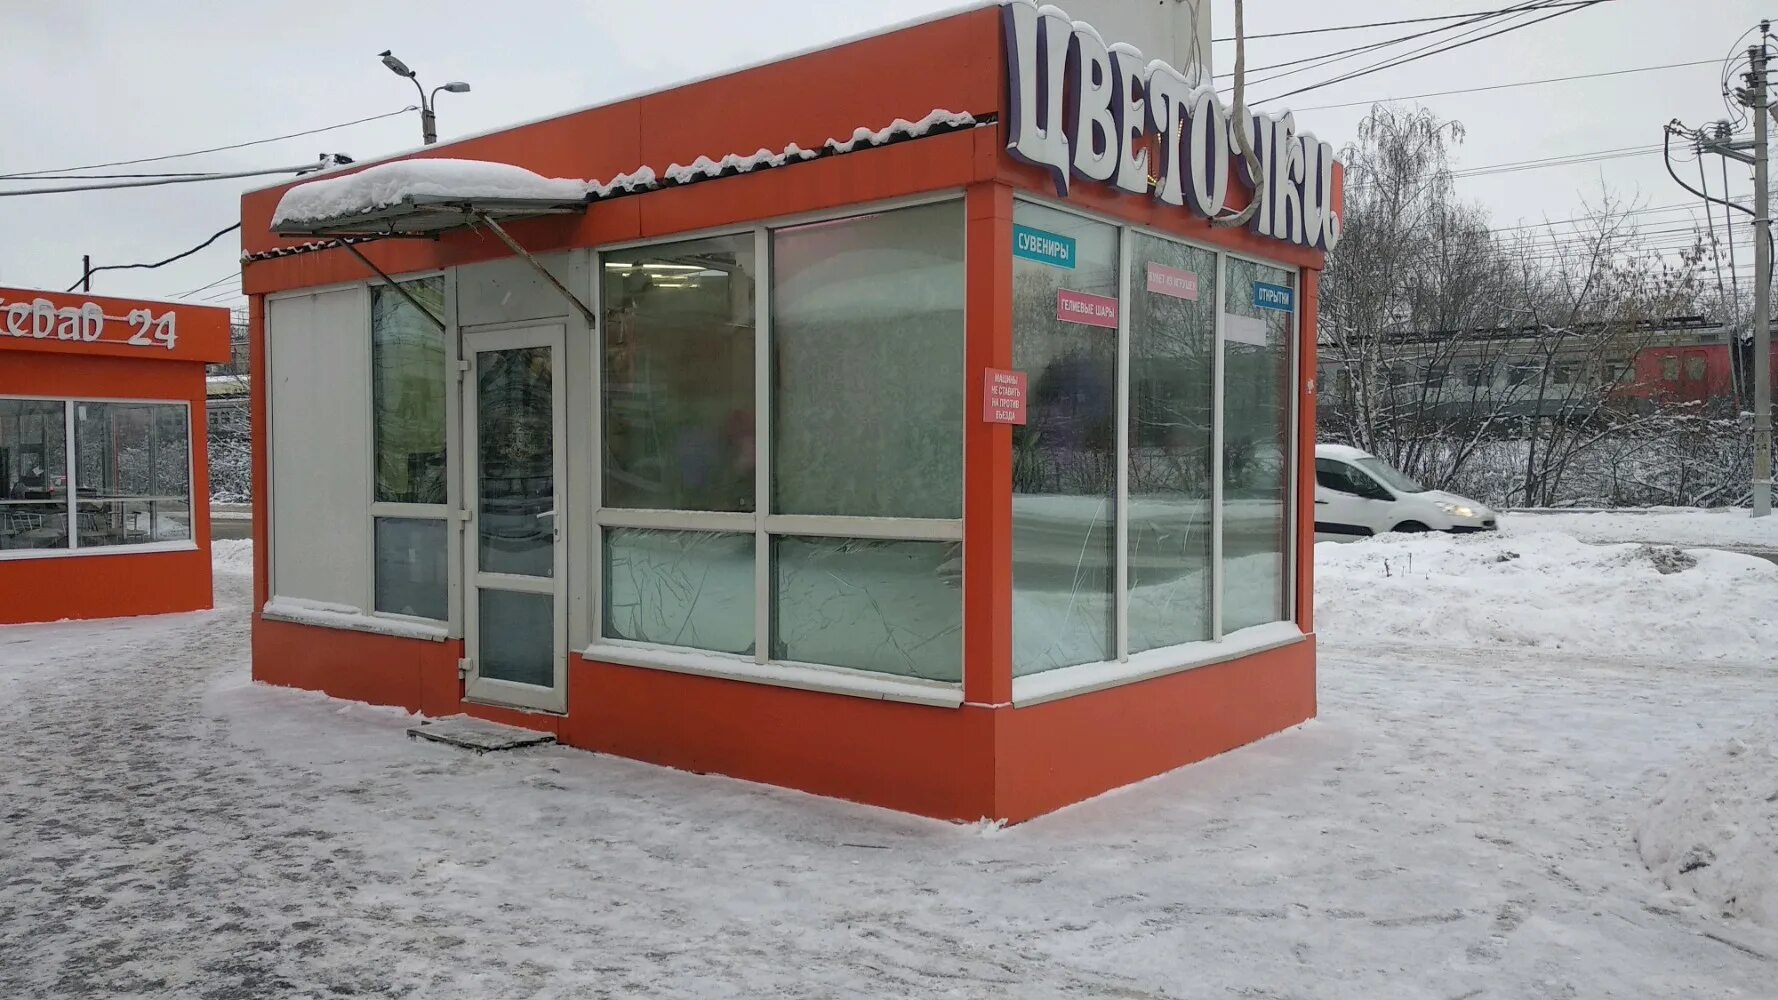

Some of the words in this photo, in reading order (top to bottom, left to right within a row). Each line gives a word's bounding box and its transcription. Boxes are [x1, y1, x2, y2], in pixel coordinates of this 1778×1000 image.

[1018, 232, 1069, 260] СУВЕНИРЫ
[1258, 287, 1290, 305] ОТКРЫТКИ
[1060, 298, 1094, 315] ГЕЛИЕВЫЕ
[1095, 305, 1115, 318] ШАРЫ
[127, 308, 178, 350] 24
[994, 373, 1019, 385] МАШИНЫ
[998, 386, 1021, 397] СТАВИТЬ
